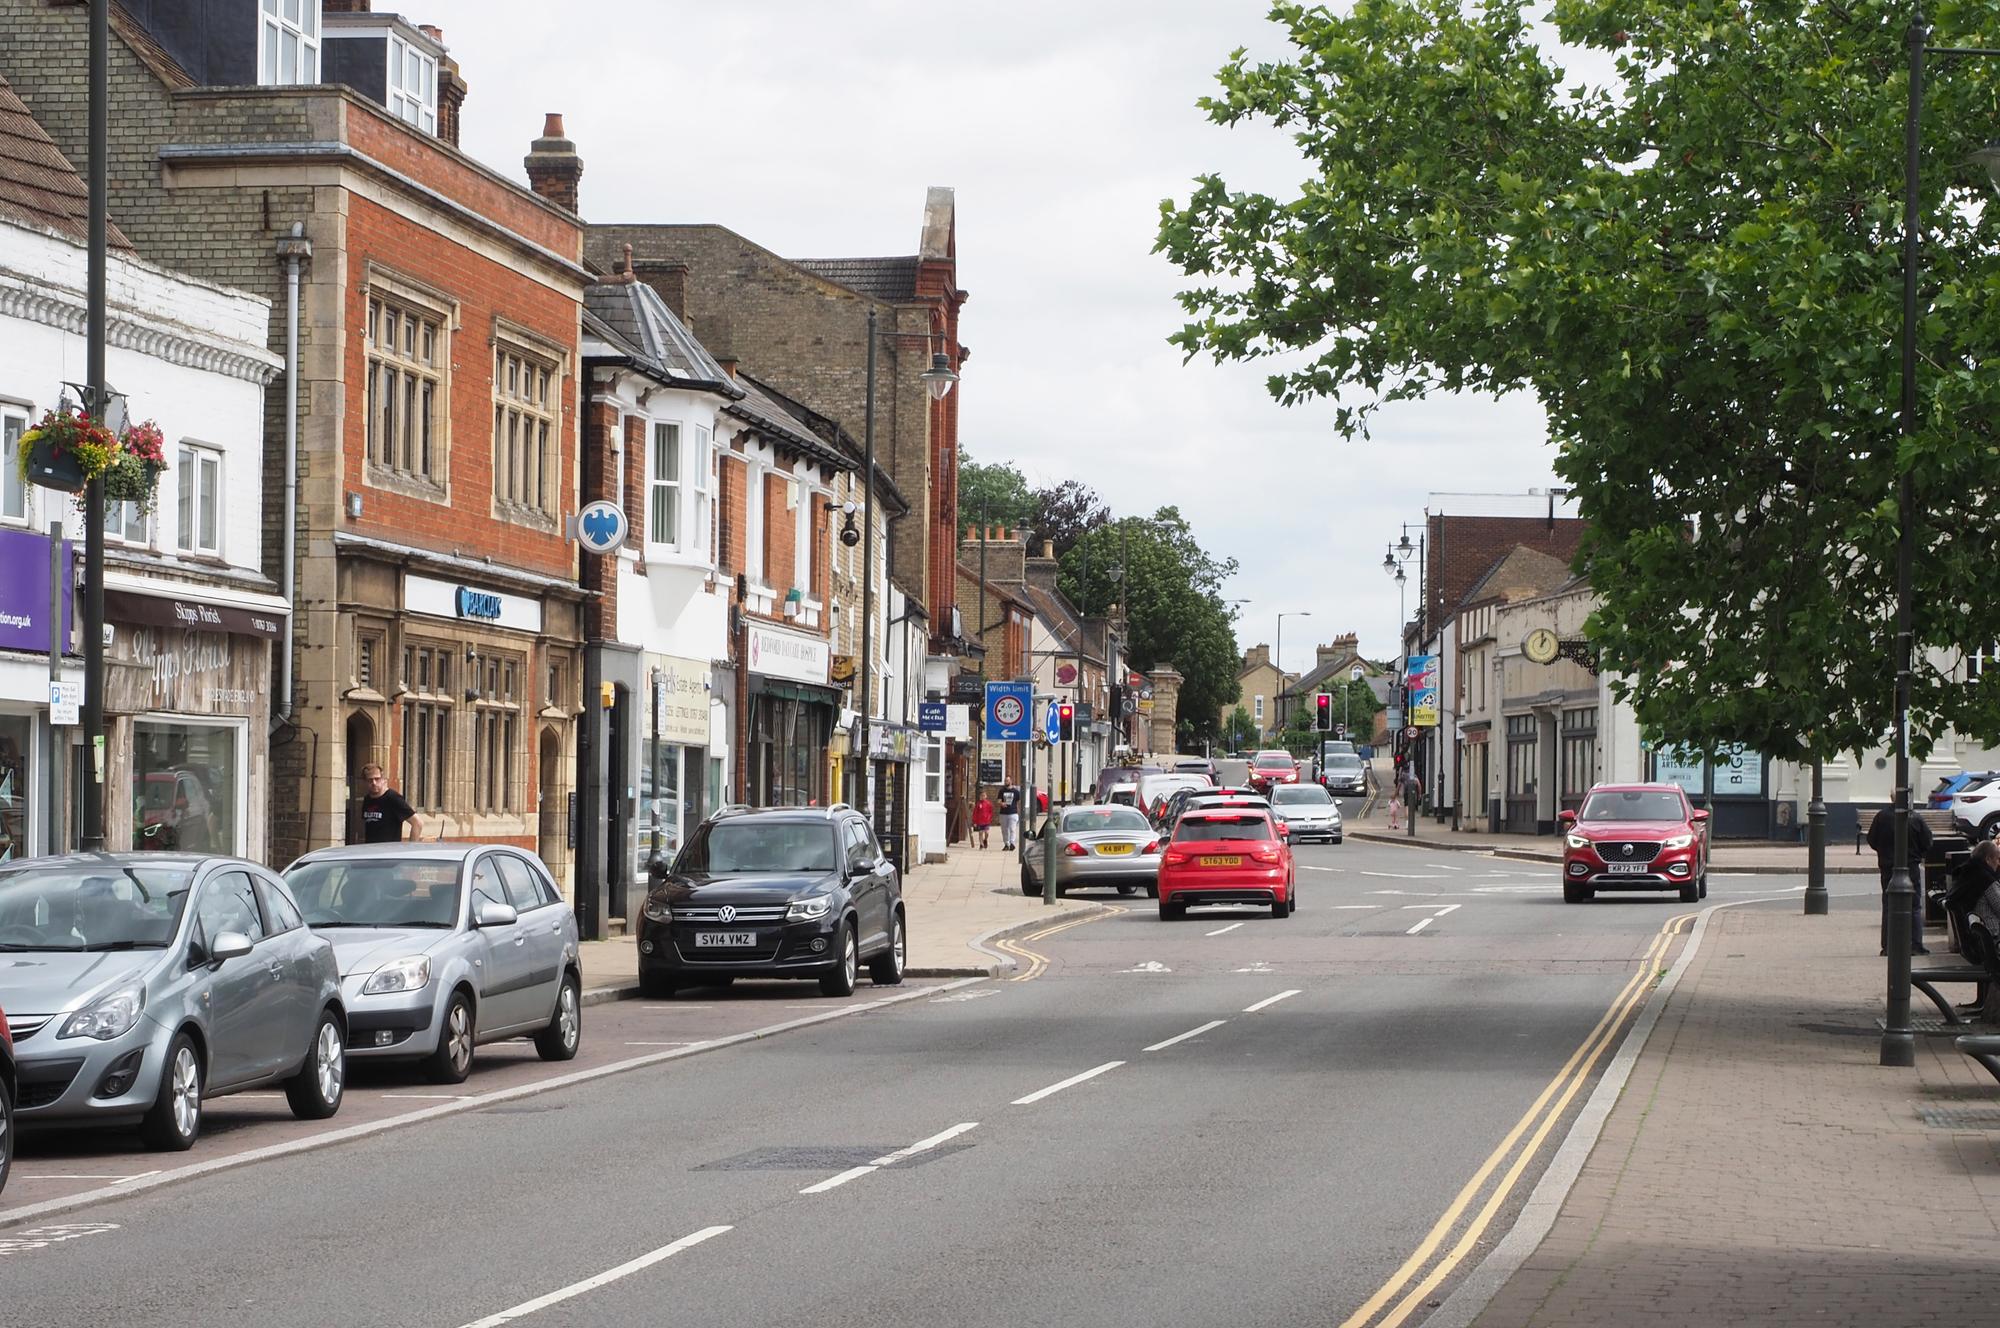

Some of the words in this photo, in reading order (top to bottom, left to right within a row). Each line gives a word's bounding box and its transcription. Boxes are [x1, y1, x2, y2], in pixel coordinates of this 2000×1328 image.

[468, 592, 502, 618] BARCLAYS
[174, 602, 198, 625] Skipps
[198, 605, 221, 623] Florist
[989, 685, 1011, 693] Width
[1012, 685, 1029, 693] limit
[1122, 700, 1134, 713] Q
[1661, 761, 1677, 769] ARTS
[1203, 857, 1223, 865] ST63
[702, 934, 725, 945] SV14
[728, 934, 750, 945] VMZ
